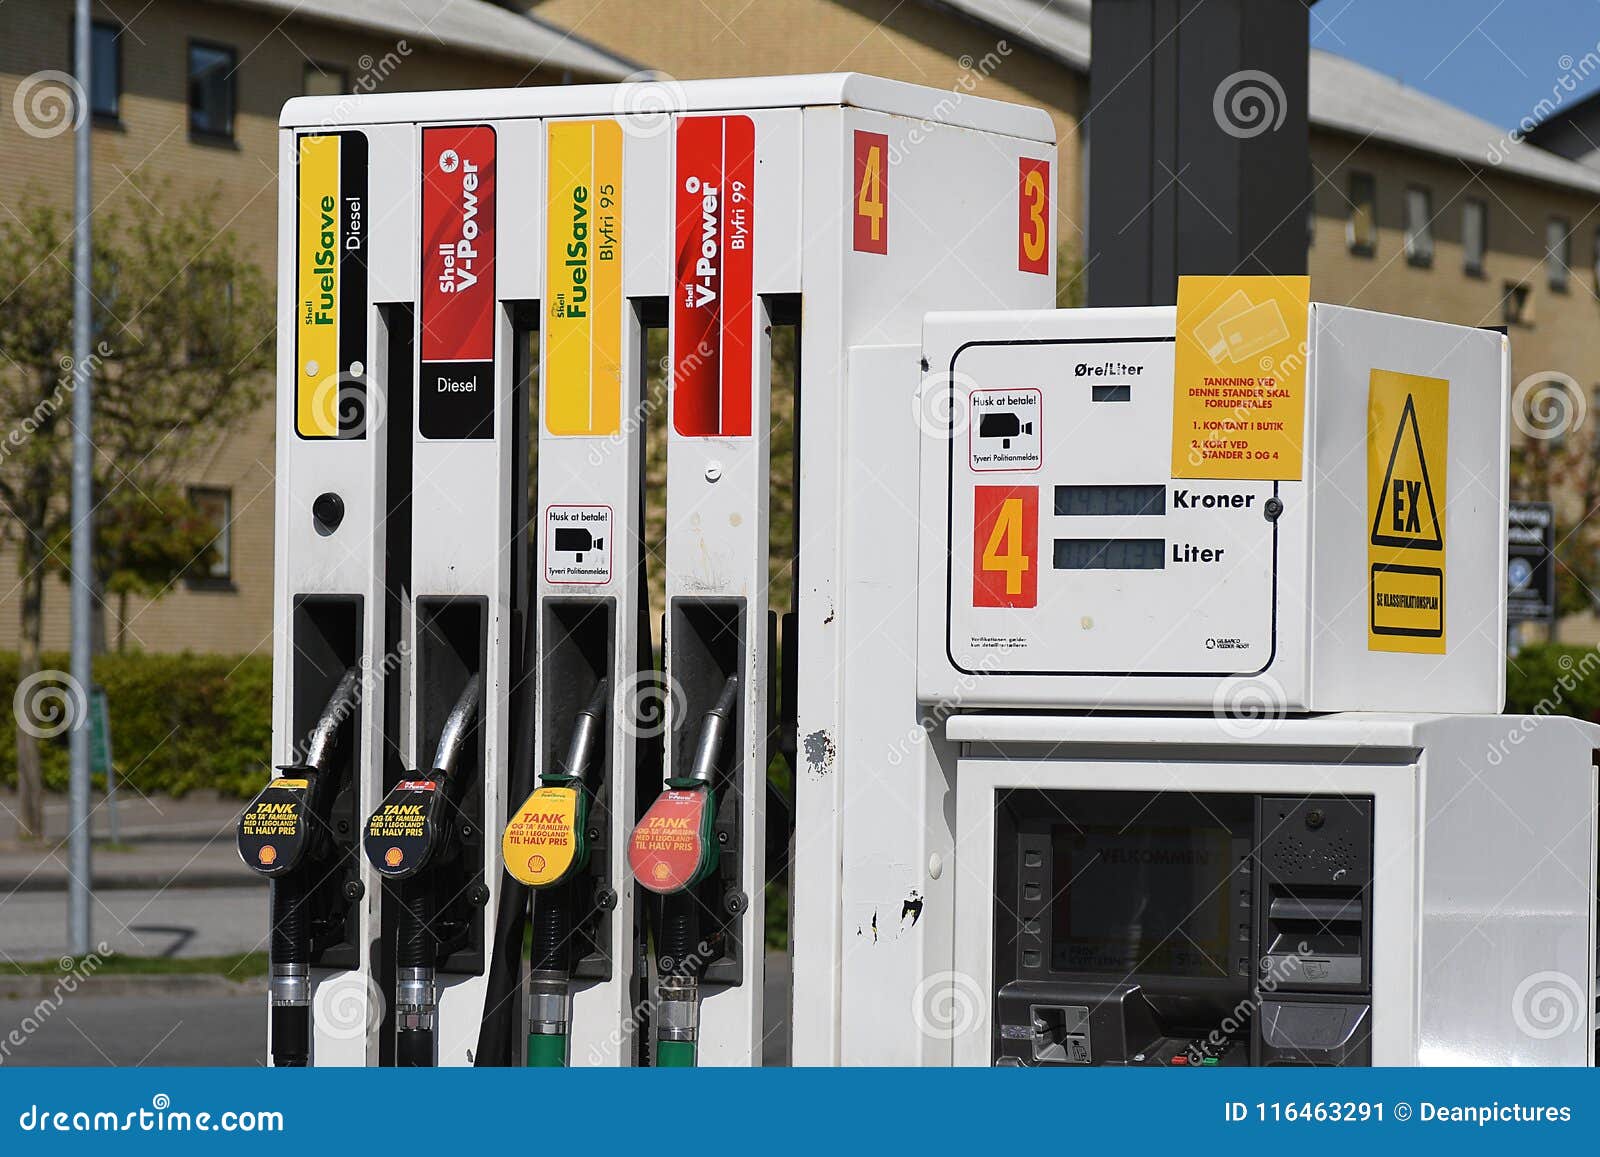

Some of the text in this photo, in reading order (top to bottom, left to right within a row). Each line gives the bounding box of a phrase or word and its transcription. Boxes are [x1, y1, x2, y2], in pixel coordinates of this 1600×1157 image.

[858, 146, 883, 240] 4
[731, 180, 749, 250] Blyfri 99
[1023, 170, 1046, 261] 3
[346, 197, 361, 250] Diesel
[456, 159, 479, 293] V-Power
[599, 184, 618, 262] Blyfri 95
[566, 185, 588, 318] FuelSave
[696, 181, 718, 309] V-Power
[314, 195, 335, 325] FuelSave
[439, 243, 455, 294] Shell
[685, 284, 693, 308] Shell
[305, 300, 313, 325] Shell
[557, 293, 565, 318] Shell
[1074, 362, 1144, 377] Øre/Liter
[437, 377, 477, 393] Diesel
[1204, 378, 1276, 387] TANKNING VED
[973, 394, 1036, 406] Husk at betale!
[1188, 388, 1290, 398] DENNE STANDER SKAL
[1205, 400, 1272, 408] FORUDBETALES
[1193, 422, 1284, 430] 1. KONTANT I BUTIK
[1192, 440, 1248, 449] 2. KORT VED
[973, 453, 1039, 464] Tyveri Politianmeldes
[1202, 451, 1243, 459] STANDER
[1255, 452, 1270, 460] OG
[1273, 452, 1279, 460] 4
[1173, 490, 1255, 508] Kroner
[1393, 479, 1421, 533] EX
[549, 512, 608, 521] Husk at betale!
[982, 498, 1029, 595] 4
[1172, 544, 1225, 563] Liter
[549, 568, 566, 576] Tyveri
[256, 804, 296, 813] TANK
[384, 805, 424, 814] TANK
[524, 813, 565, 824] TANK
[649, 818, 691, 828] TANK
[279, 827, 296, 835] PRIS
[523, 837, 546, 845] HALV
[549, 838, 568, 846] PRIS
[649, 842, 671, 850] HALV
